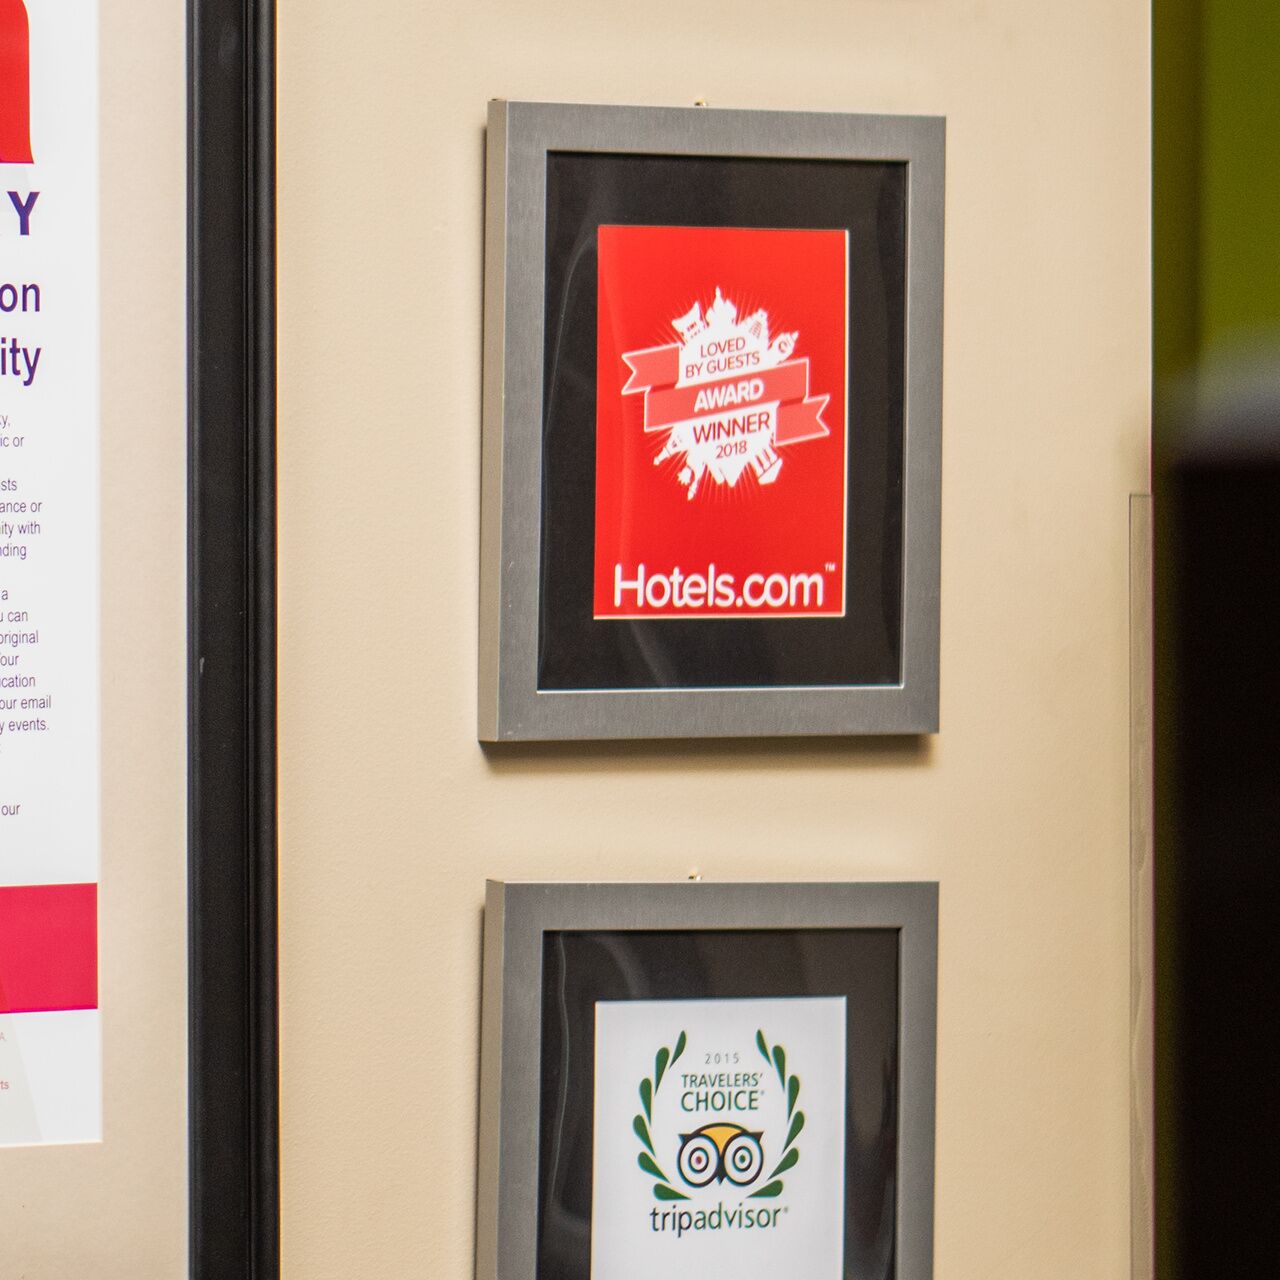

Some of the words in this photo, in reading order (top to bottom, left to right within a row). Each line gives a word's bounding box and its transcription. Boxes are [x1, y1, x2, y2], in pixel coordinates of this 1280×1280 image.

[700, 337, 746, 357] LOVED
[686, 363, 704, 378] BY
[707, 352, 760, 375] GUESTS
[694, 378, 764, 412] AWARD
[693, 412, 770, 443] WINNER
[13, 436, 24, 448] or
[715, 441, 748, 460] 2018
[614, 563, 824, 608] Hotels.com
[1, 591, 8, 601] a
[1, 805, 20, 816] our
[705, 1053, 739, 1065] 2015
[681, 1091, 759, 1112] CHOICE
[650, 1202, 782, 1238] tripadvisor
